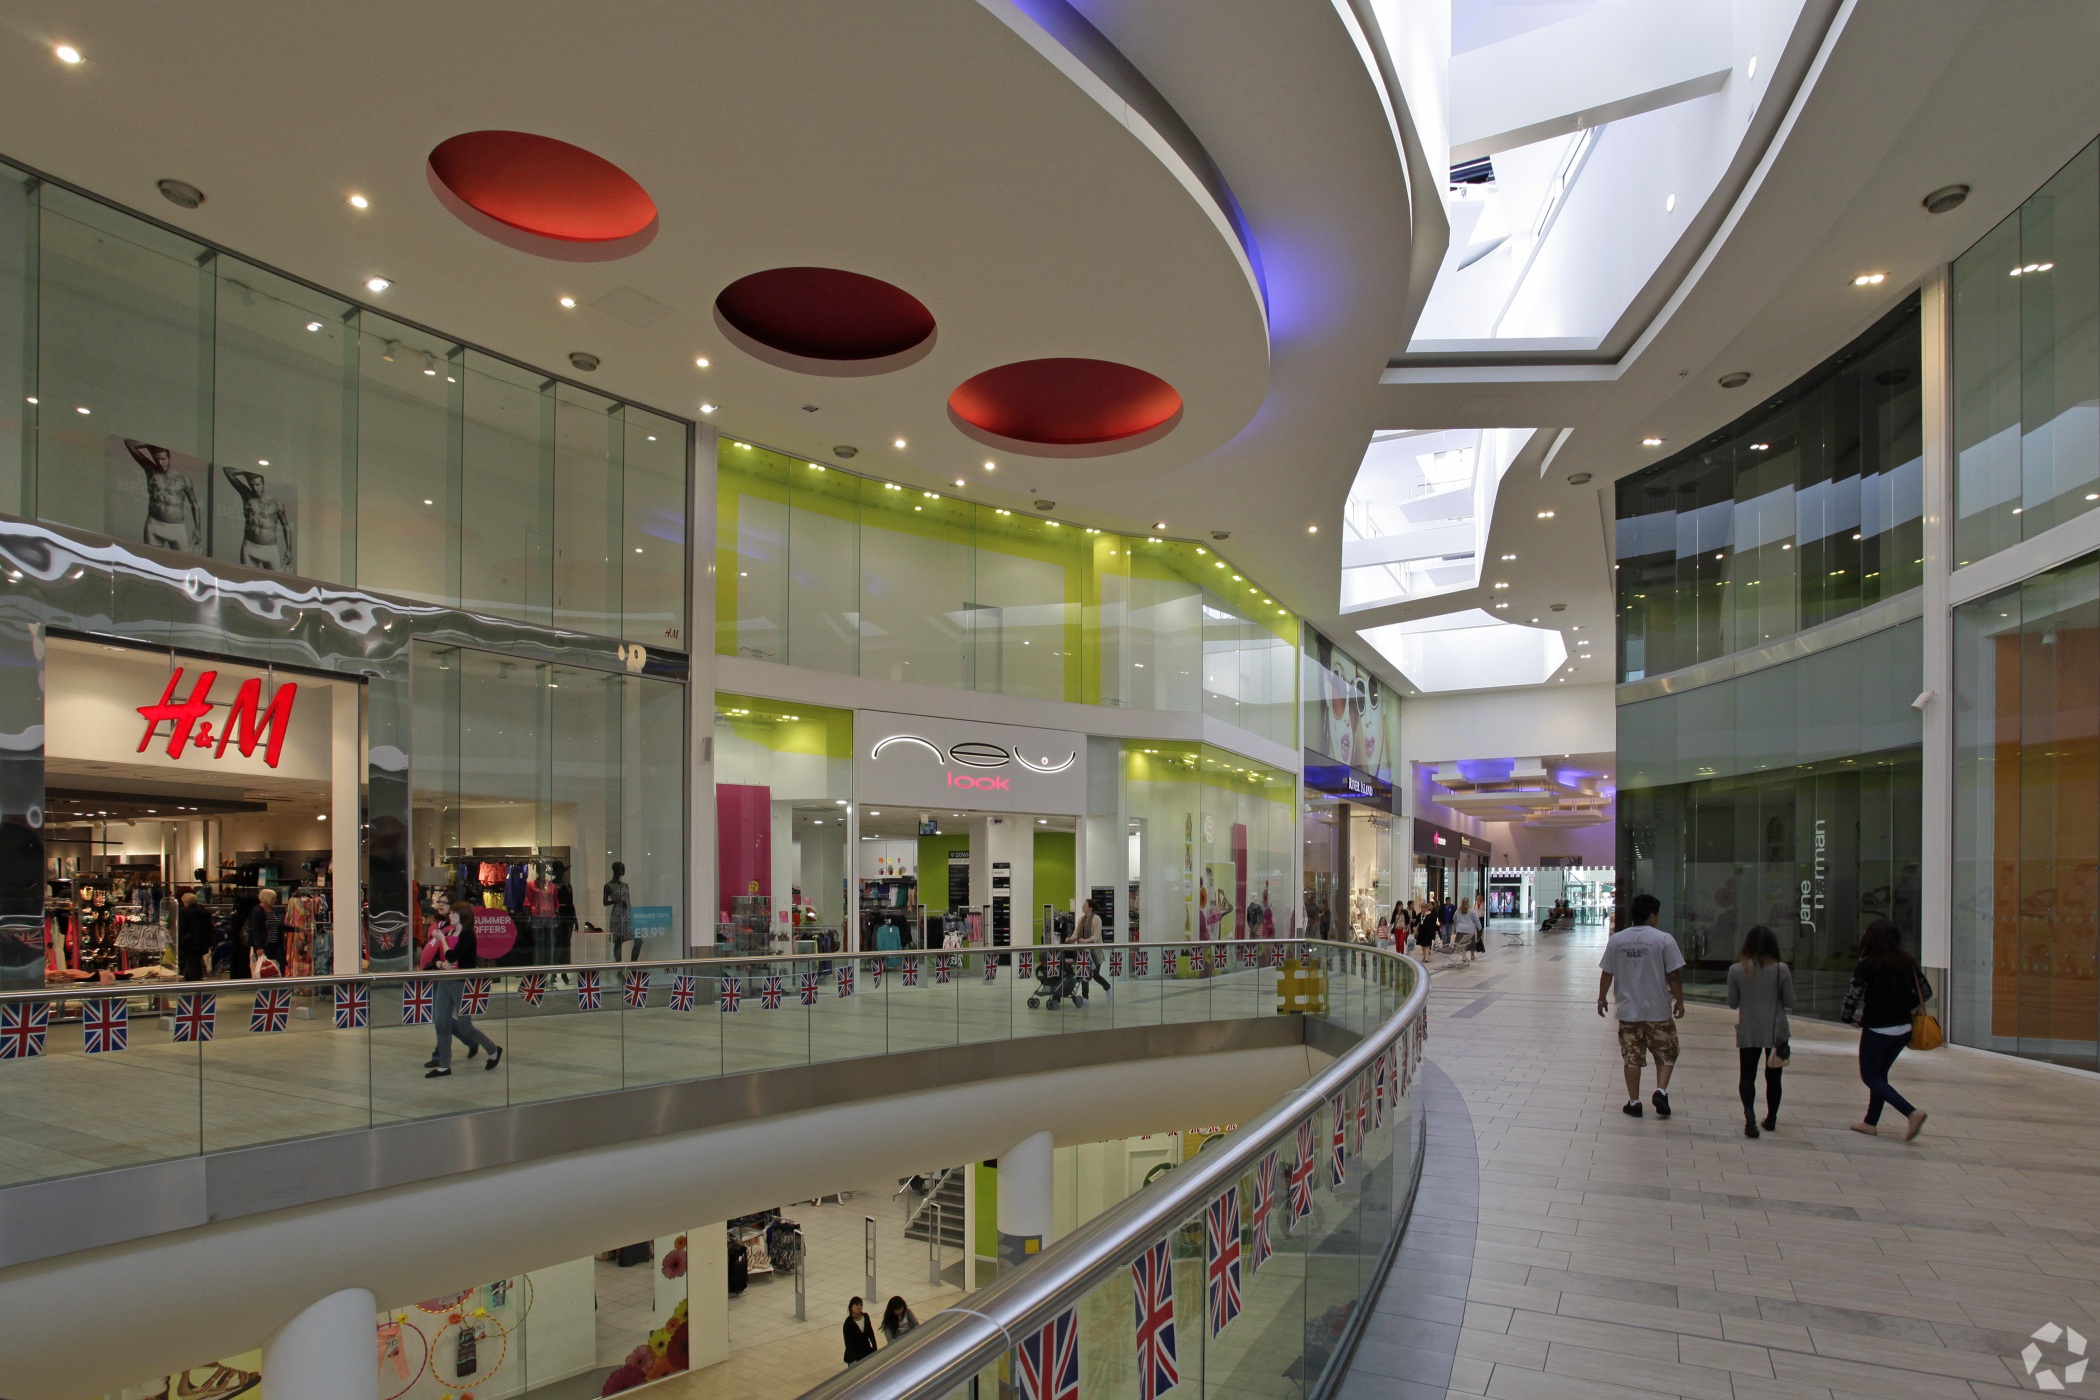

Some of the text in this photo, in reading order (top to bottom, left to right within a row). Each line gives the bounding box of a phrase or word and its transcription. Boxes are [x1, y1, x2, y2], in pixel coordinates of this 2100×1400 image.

[136, 666, 298, 769] H&M
[871, 734, 1076, 774] new
[947, 771, 1011, 791] look
[474, 916, 511, 925] SUMMER
[1800, 880, 1816, 932] jane
[634, 926, 666, 939] £3.99
